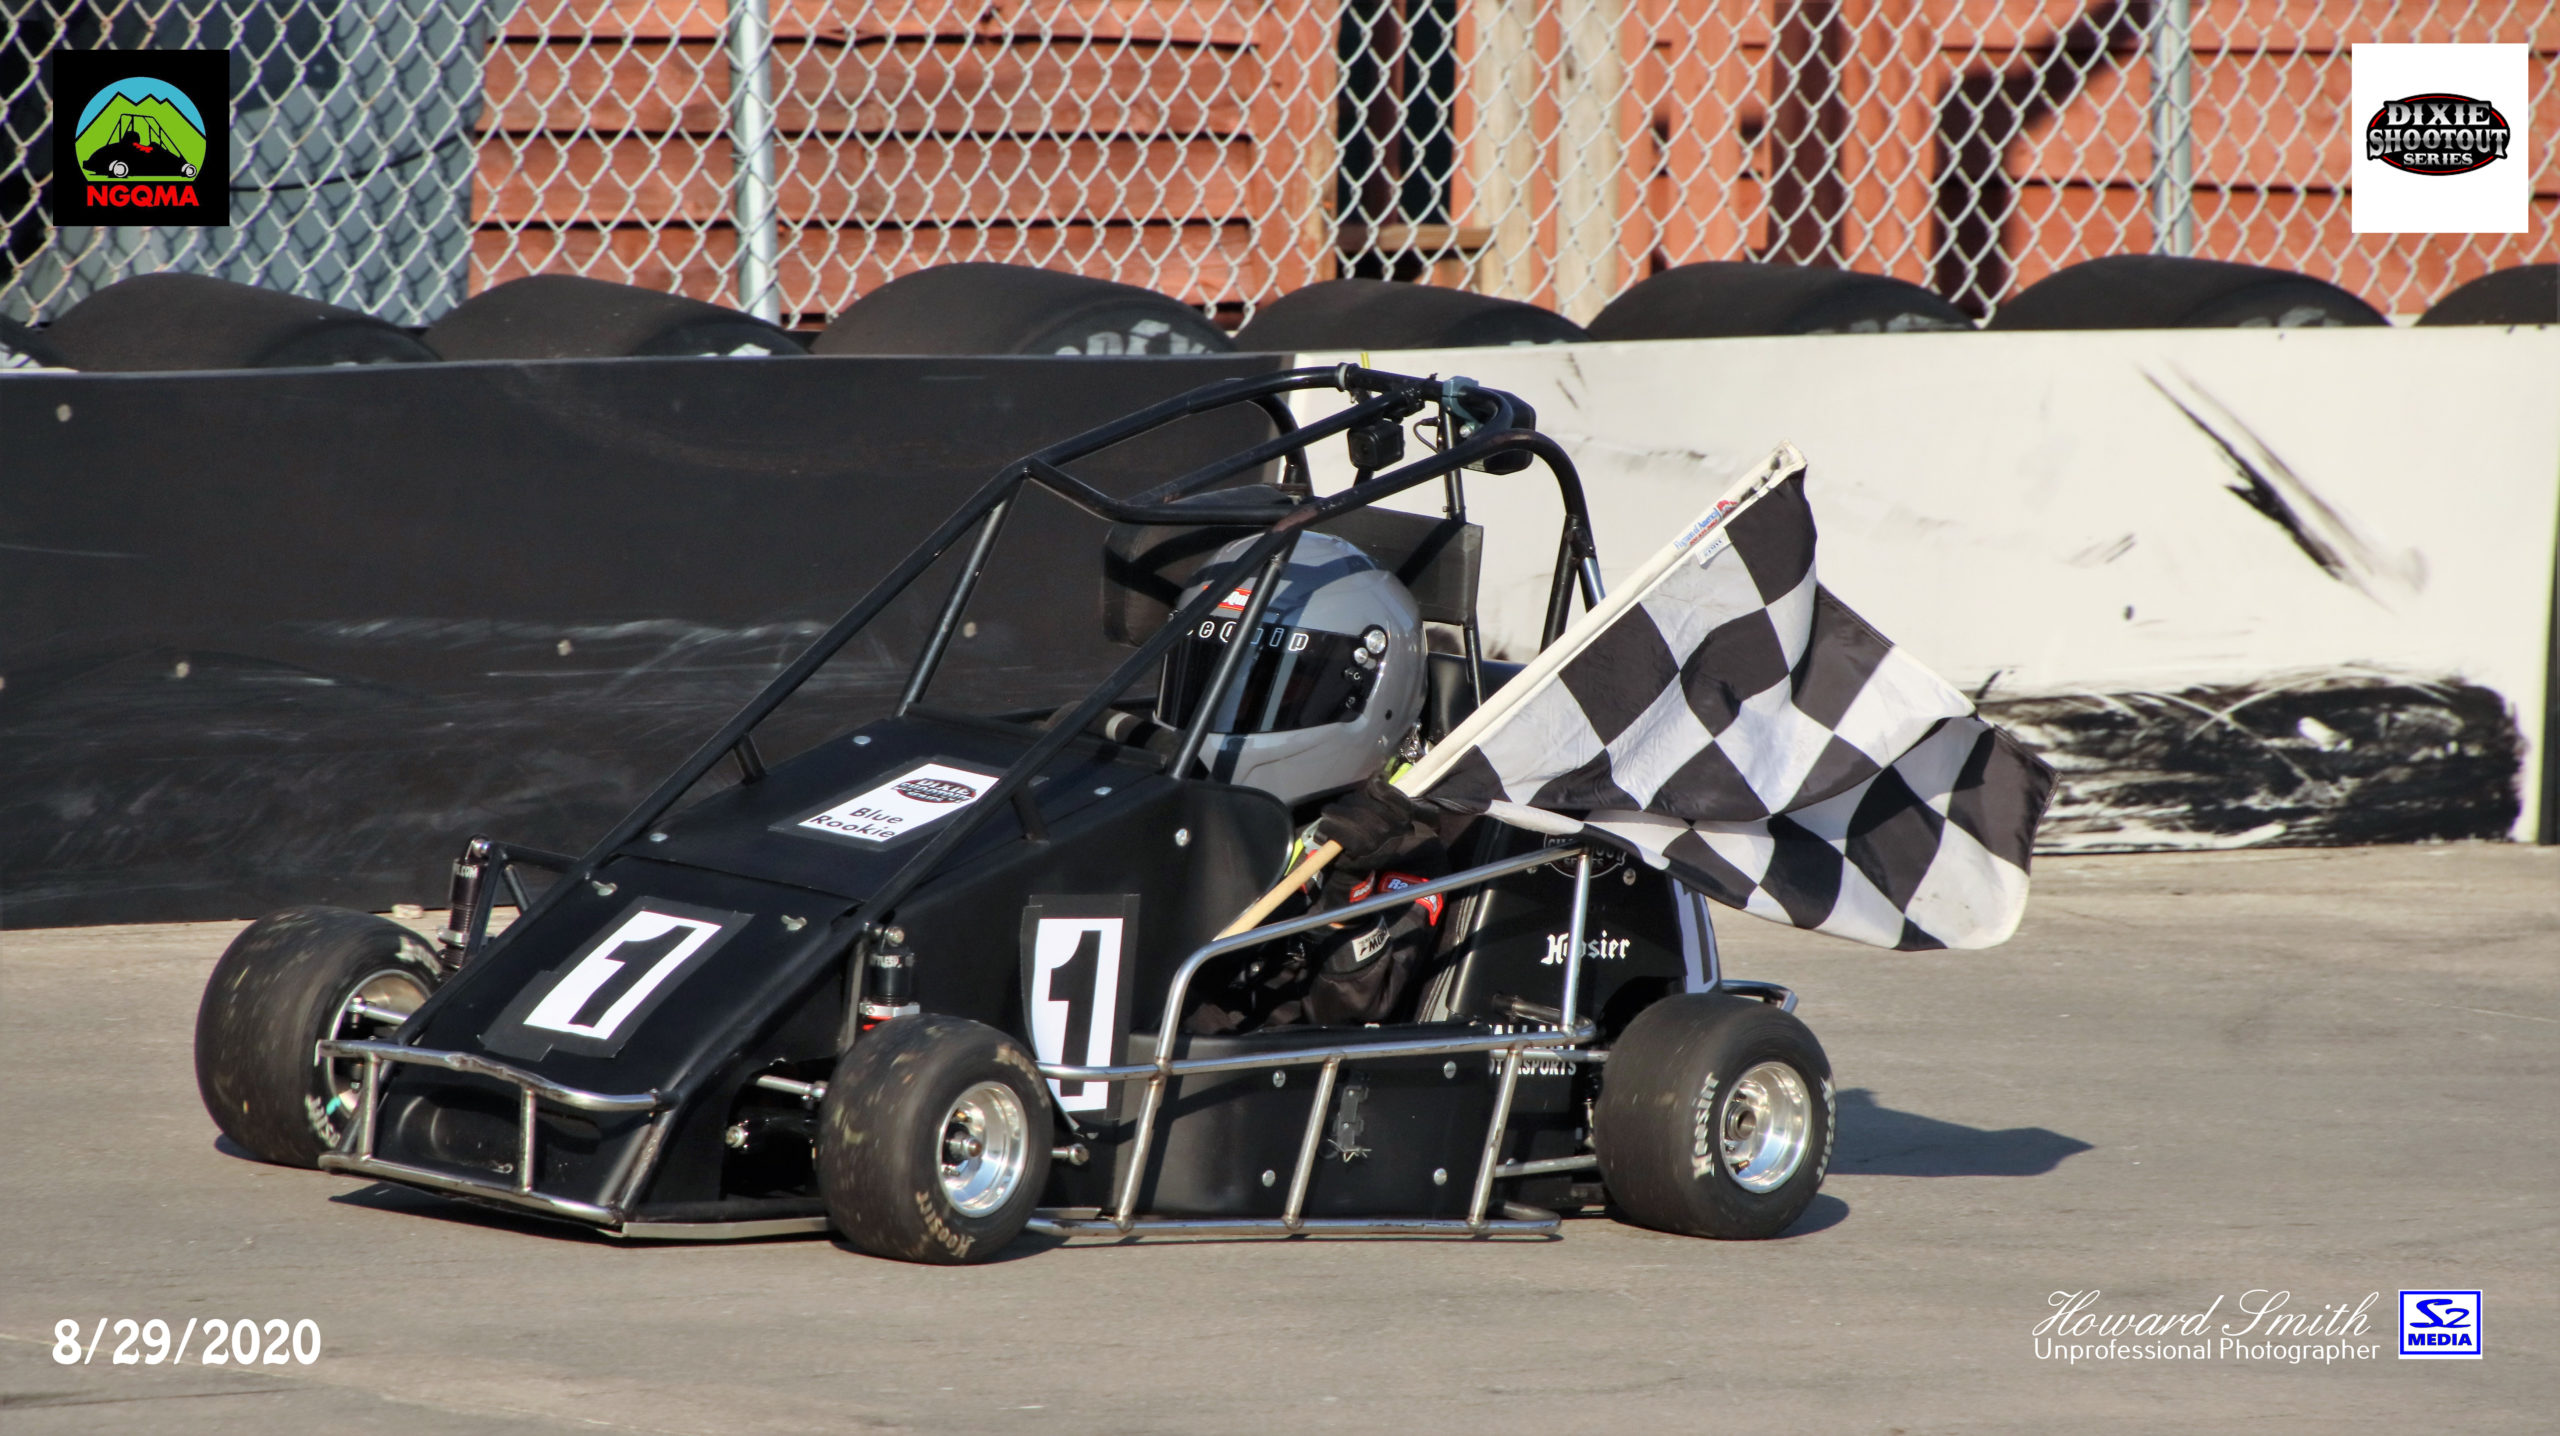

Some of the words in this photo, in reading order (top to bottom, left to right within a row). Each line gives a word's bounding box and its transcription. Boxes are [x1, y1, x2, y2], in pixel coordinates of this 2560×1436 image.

[809, 815, 896, 838] Rookie
[848, 807, 903, 825] Blue
[568, 925, 698, 1028] 1
[1048, 930, 1102, 1097] 1
[304, 1093, 342, 1148] osier
